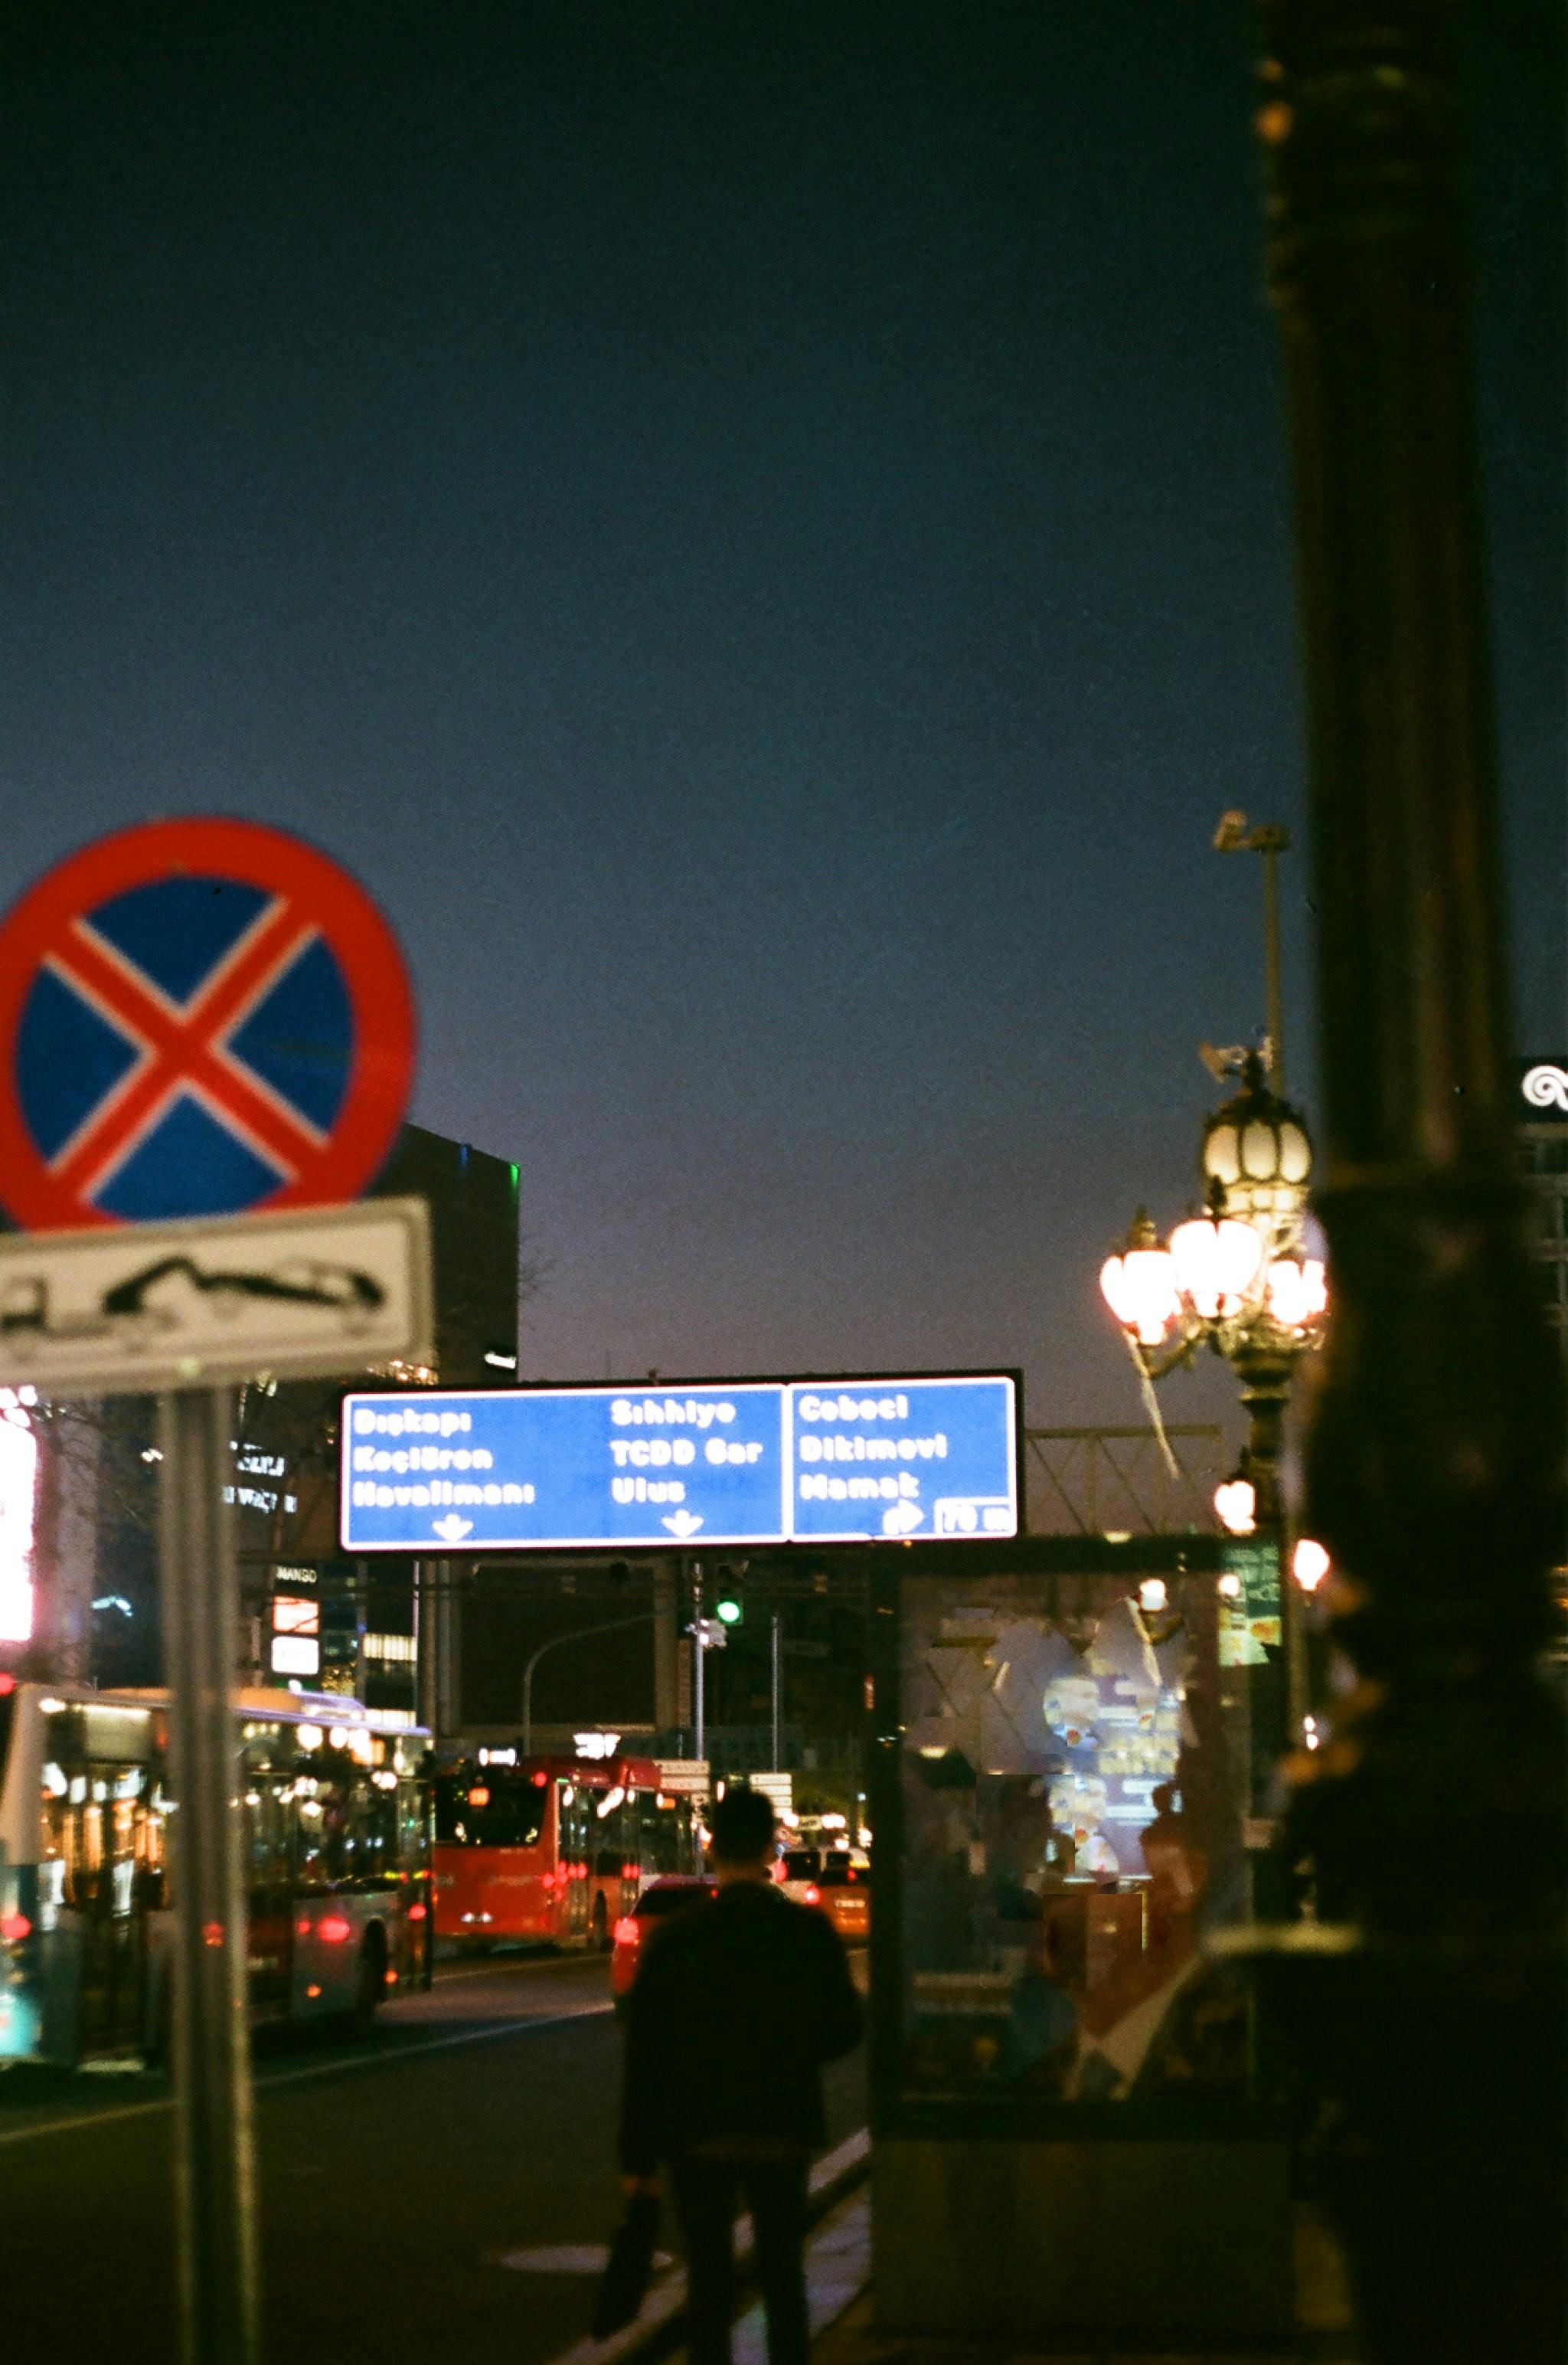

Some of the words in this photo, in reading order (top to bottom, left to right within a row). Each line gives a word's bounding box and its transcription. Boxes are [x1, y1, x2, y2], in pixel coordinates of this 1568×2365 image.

[799, 1395, 908, 1421] Cebeci
[610, 1438, 695, 1467] TCDD
[705, 1437, 763, 1464] Gar
[799, 1433, 947, 1461] Dikimevi
[353, 1480, 534, 1507] Havalimanı
[612, 1477, 685, 1503] Ulus
[799, 1471, 919, 1500] Mamak
[942, 1505, 976, 1532] 70
